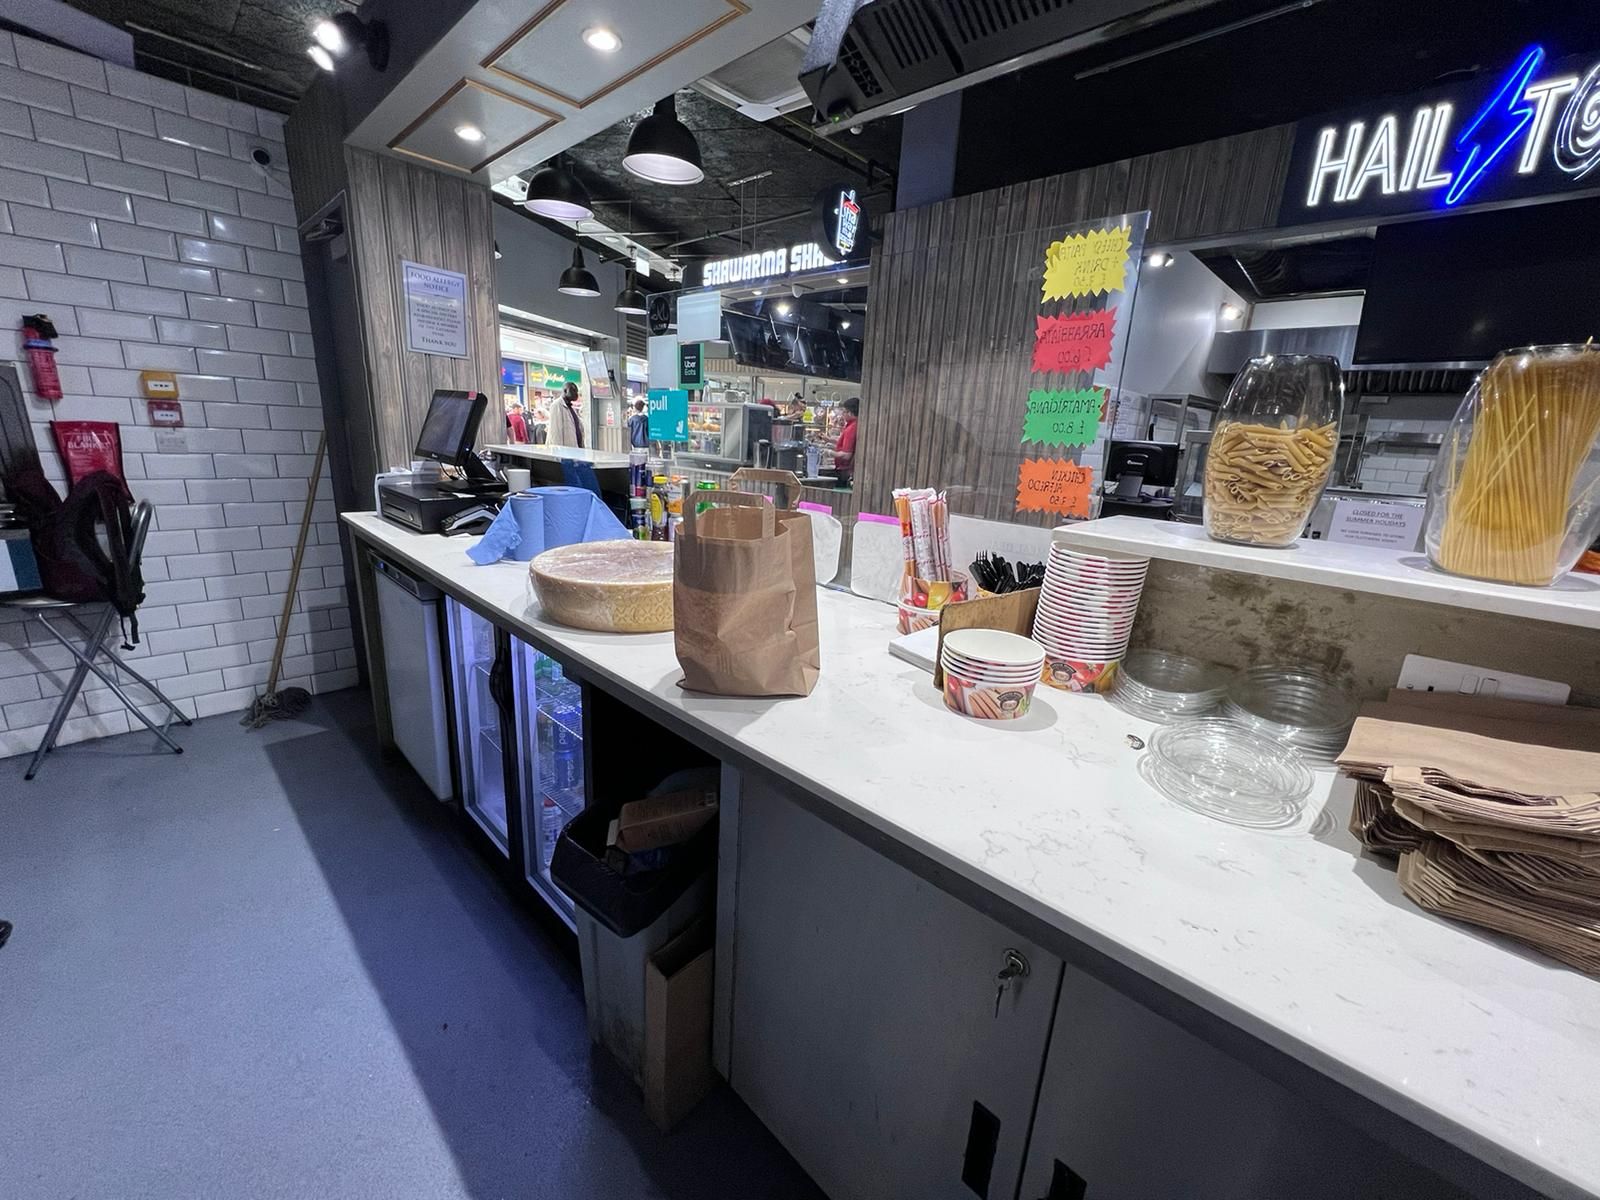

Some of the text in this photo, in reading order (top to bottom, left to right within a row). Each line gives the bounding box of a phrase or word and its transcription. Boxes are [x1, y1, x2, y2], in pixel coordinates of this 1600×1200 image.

[1306, 101, 1454, 207] HAIL
[703, 248, 787, 287] SHAWARMA
[410, 271, 432, 282] FOOD
[424, 281, 449, 293] NOTICE
[421, 336, 444, 346] THANK
[650, 395, 668, 415] pull
[1352, 509, 1404, 520] CLOSED FOR THE
[1346, 516, 1406, 528] SUMMER HOLIDAYS
